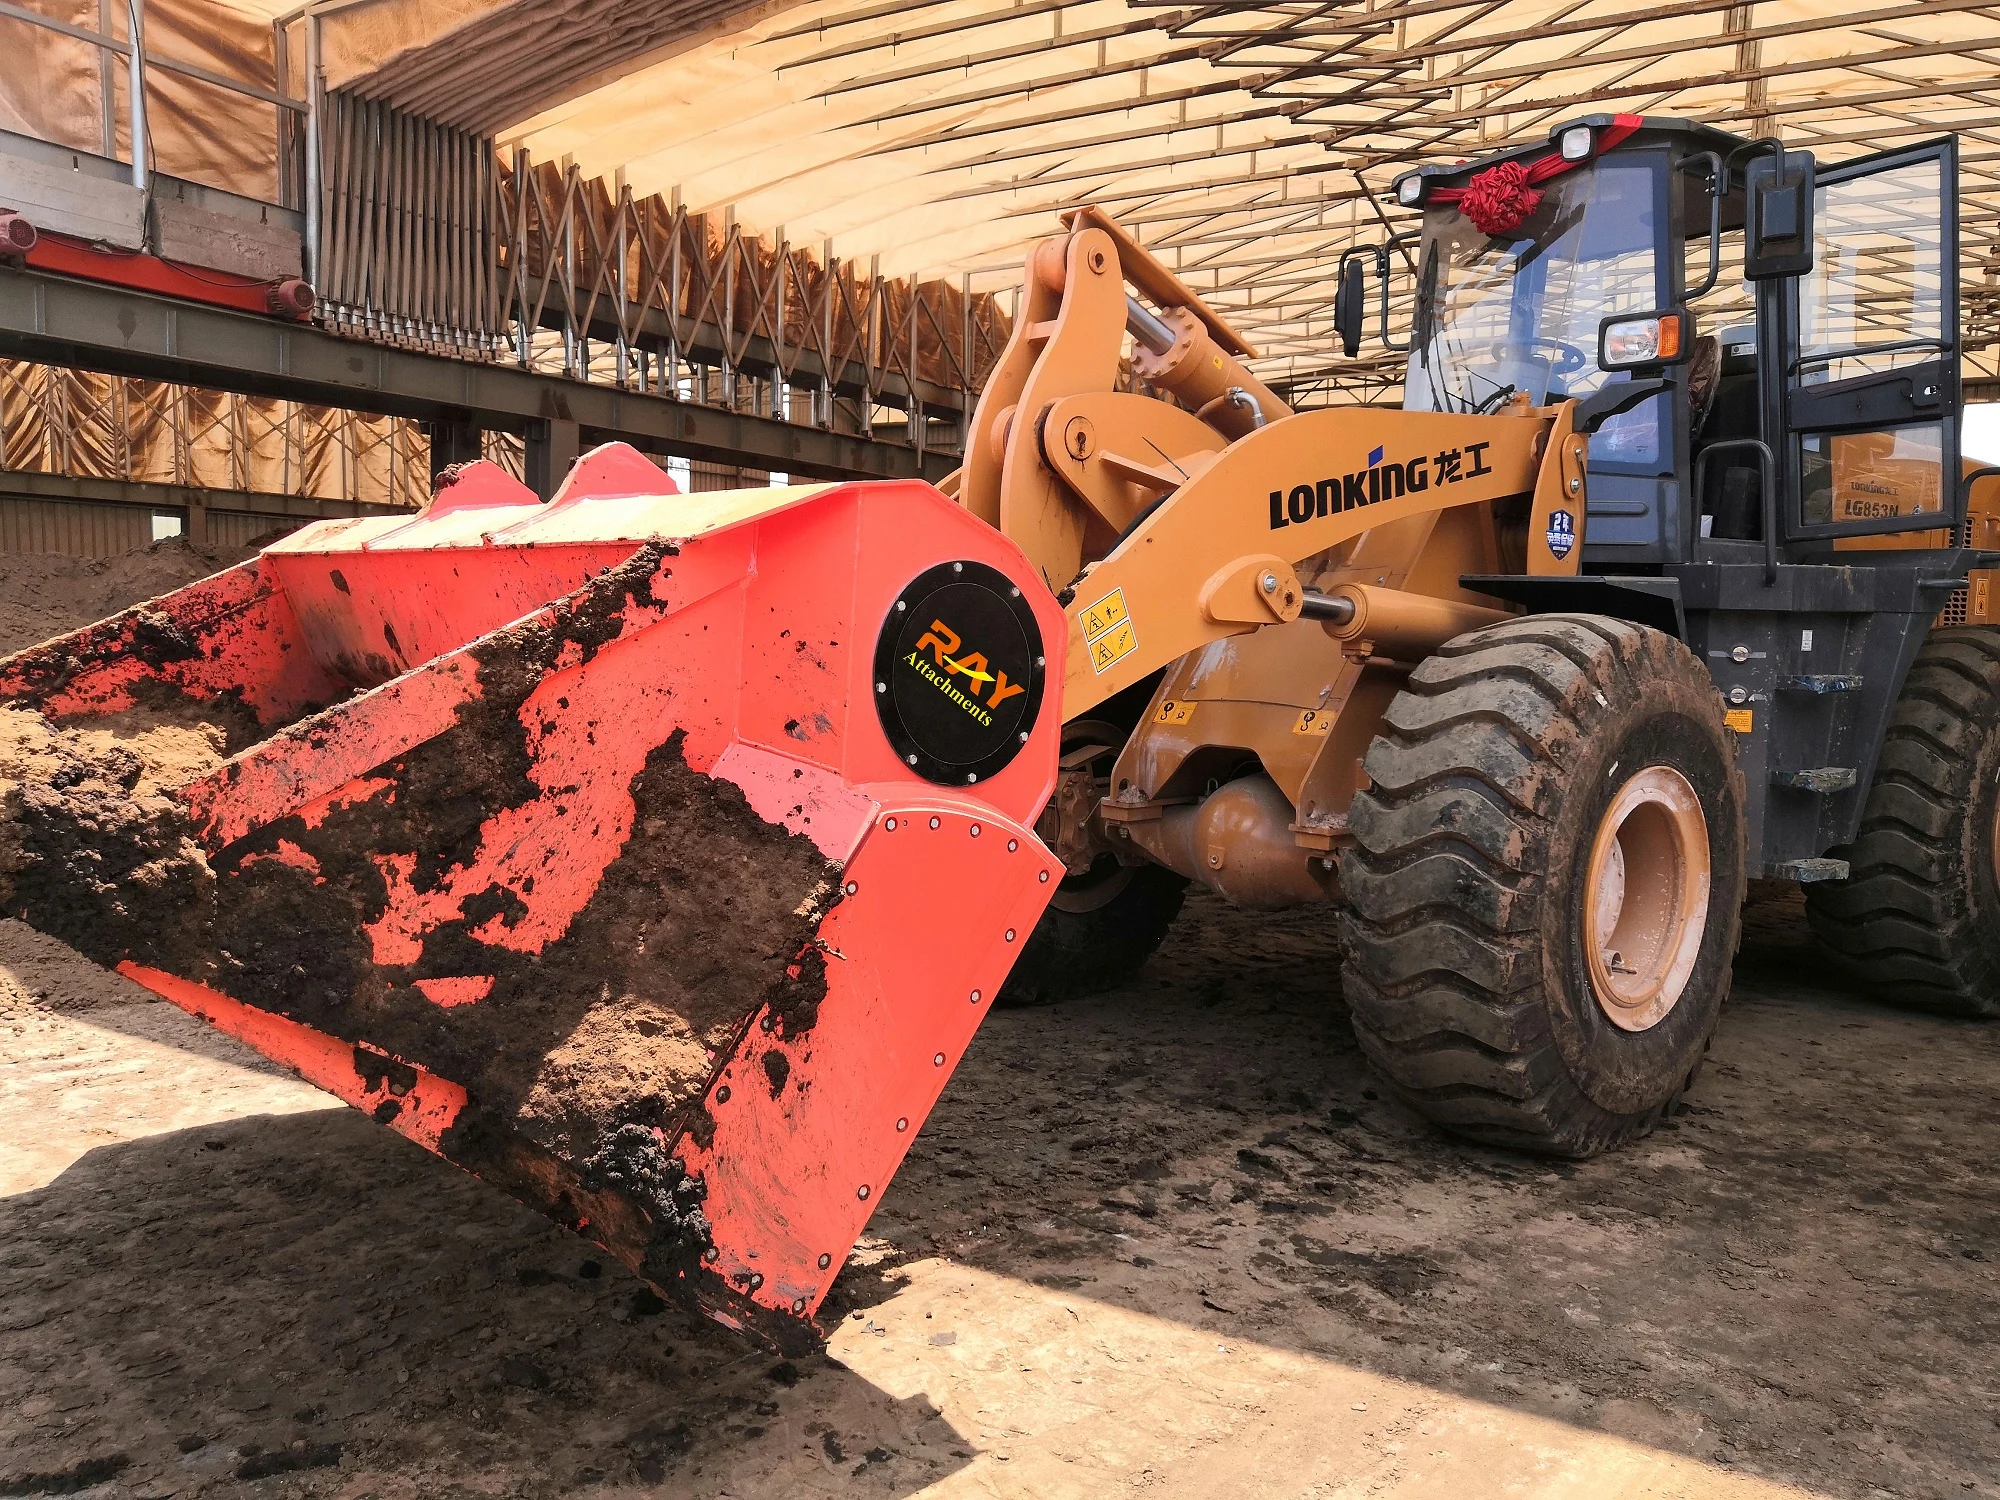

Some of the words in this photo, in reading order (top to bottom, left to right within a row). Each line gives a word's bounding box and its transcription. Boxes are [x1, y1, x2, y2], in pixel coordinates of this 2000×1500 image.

[1433, 441, 1492, 487] 龙工
[1845, 499, 1899, 518] LG853N
[903, 651, 993, 727] Attachments
[915, 618, 1025, 710] RAY
